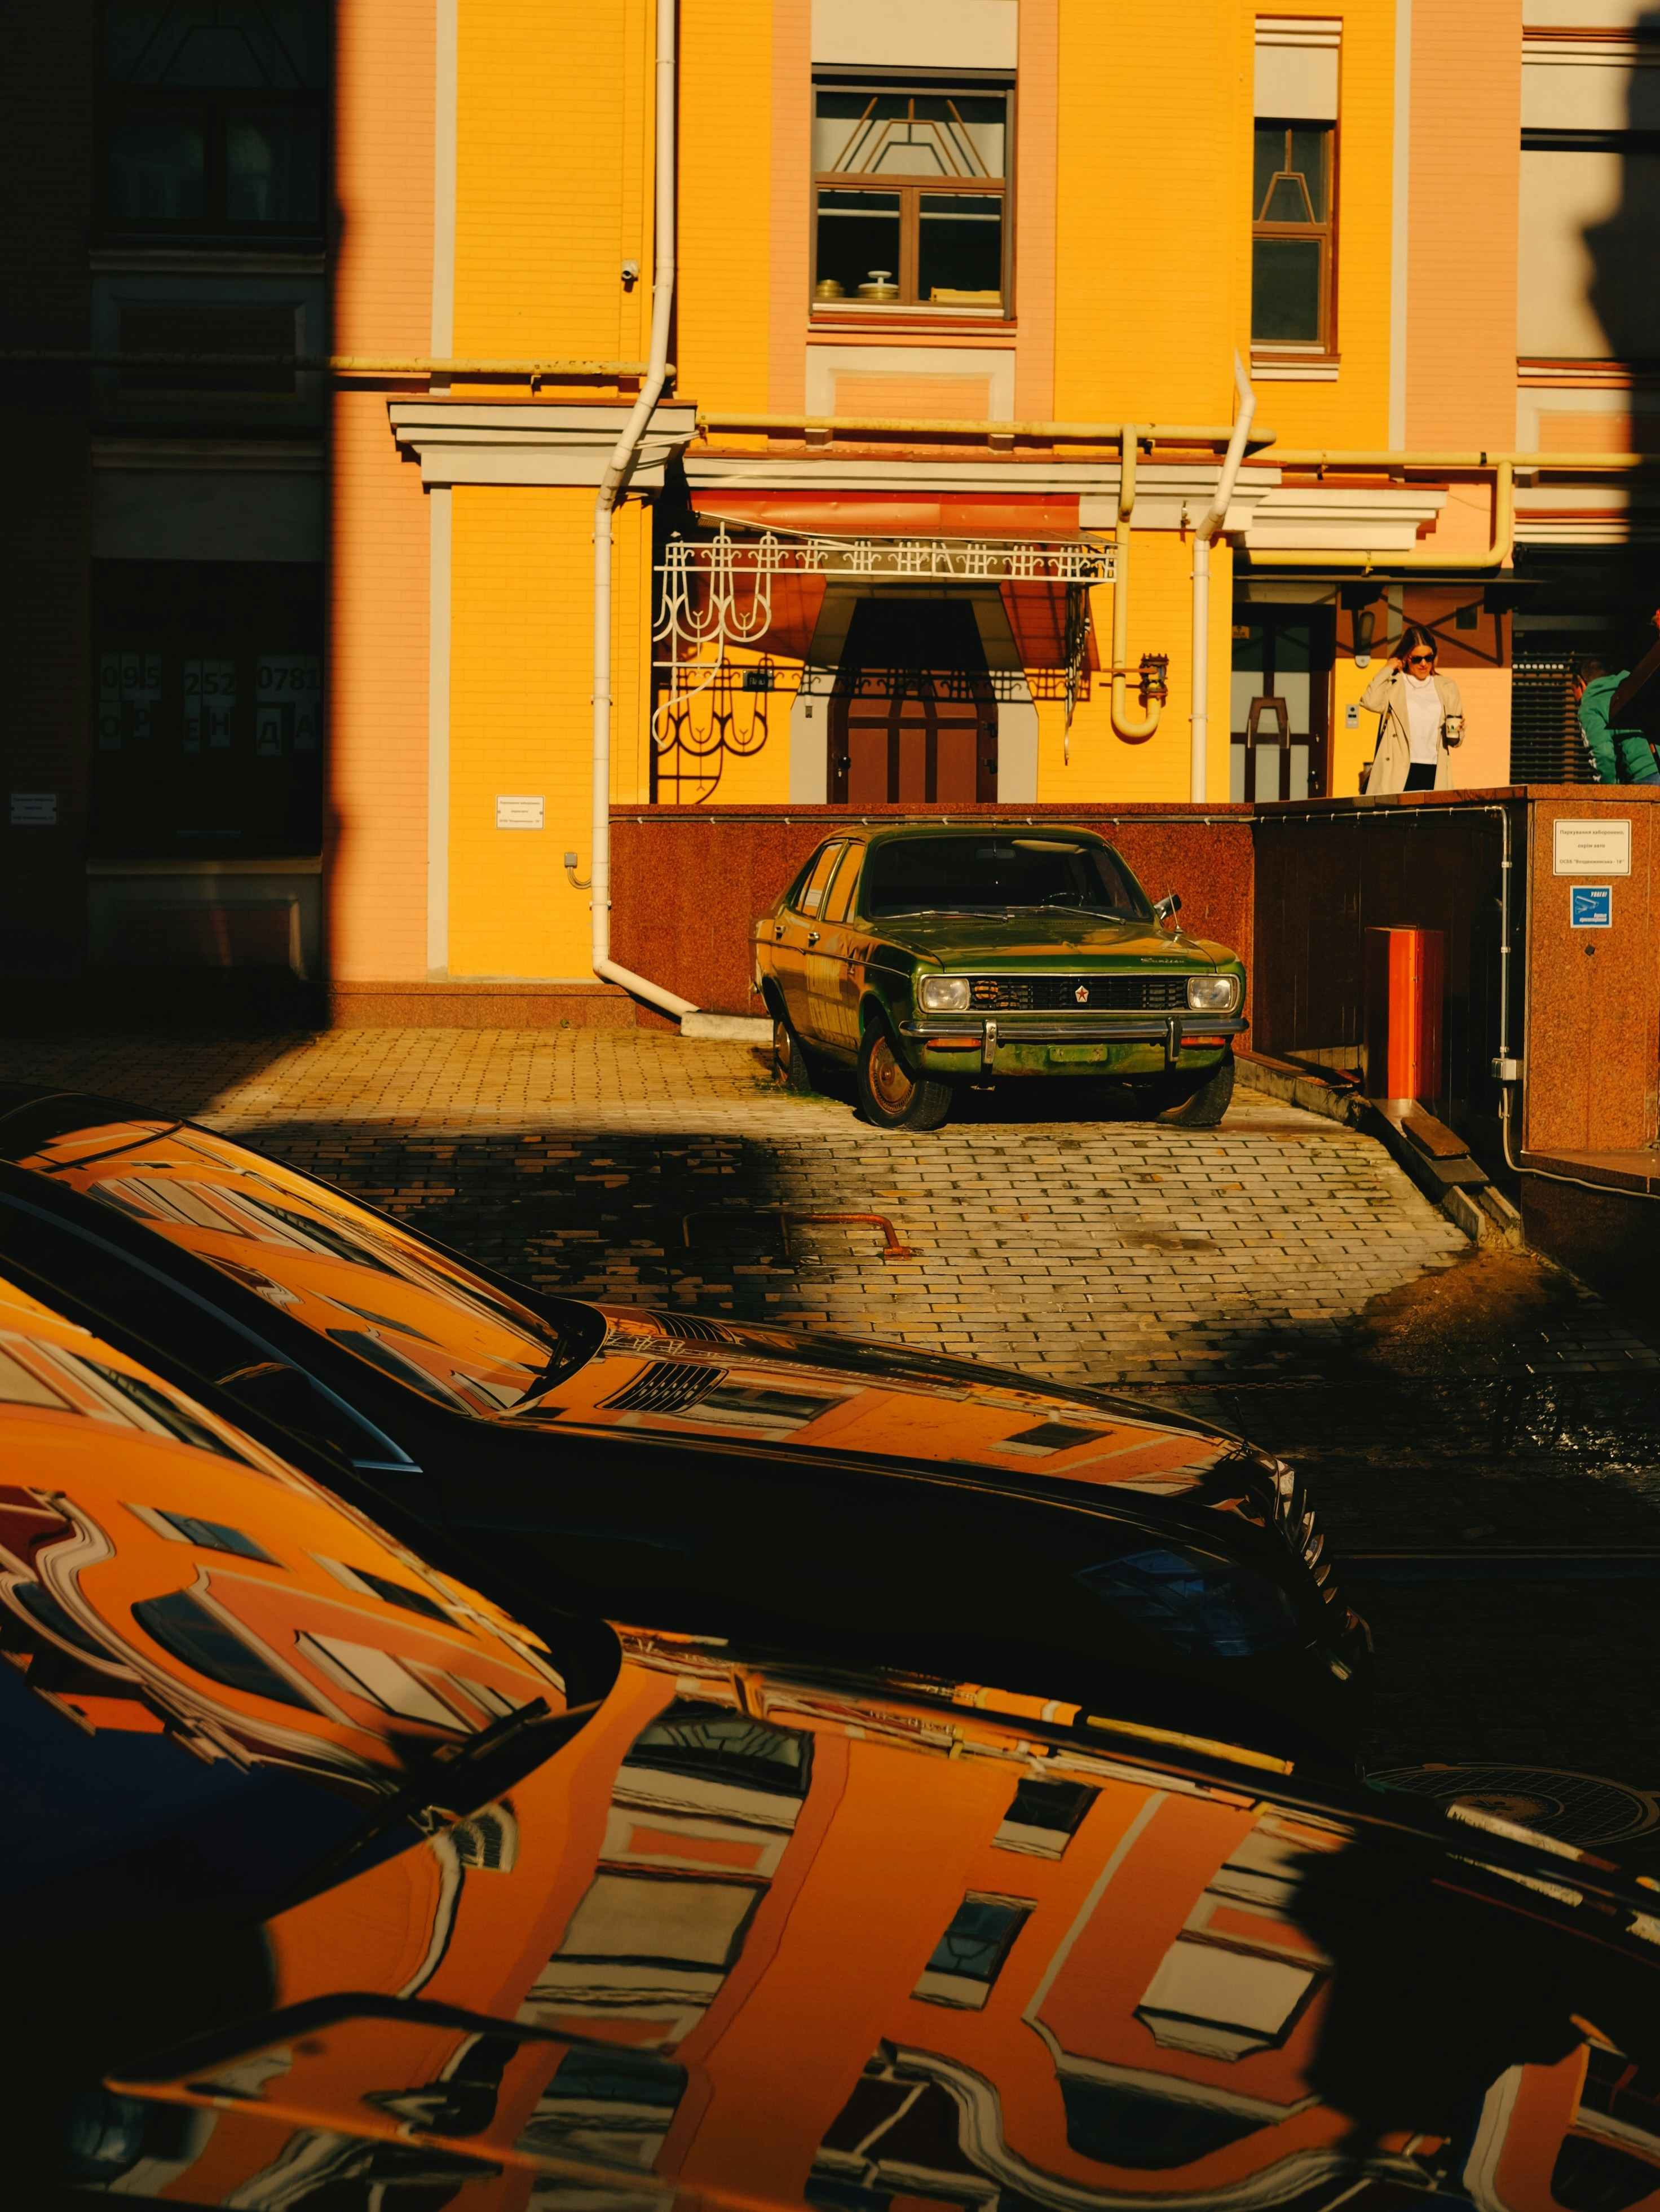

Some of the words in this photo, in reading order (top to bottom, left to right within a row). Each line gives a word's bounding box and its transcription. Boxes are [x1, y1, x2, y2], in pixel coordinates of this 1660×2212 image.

[101, 665, 161, 691] 095
[184, 673, 236, 696] 252
[257, 666, 320, 691] 0781
